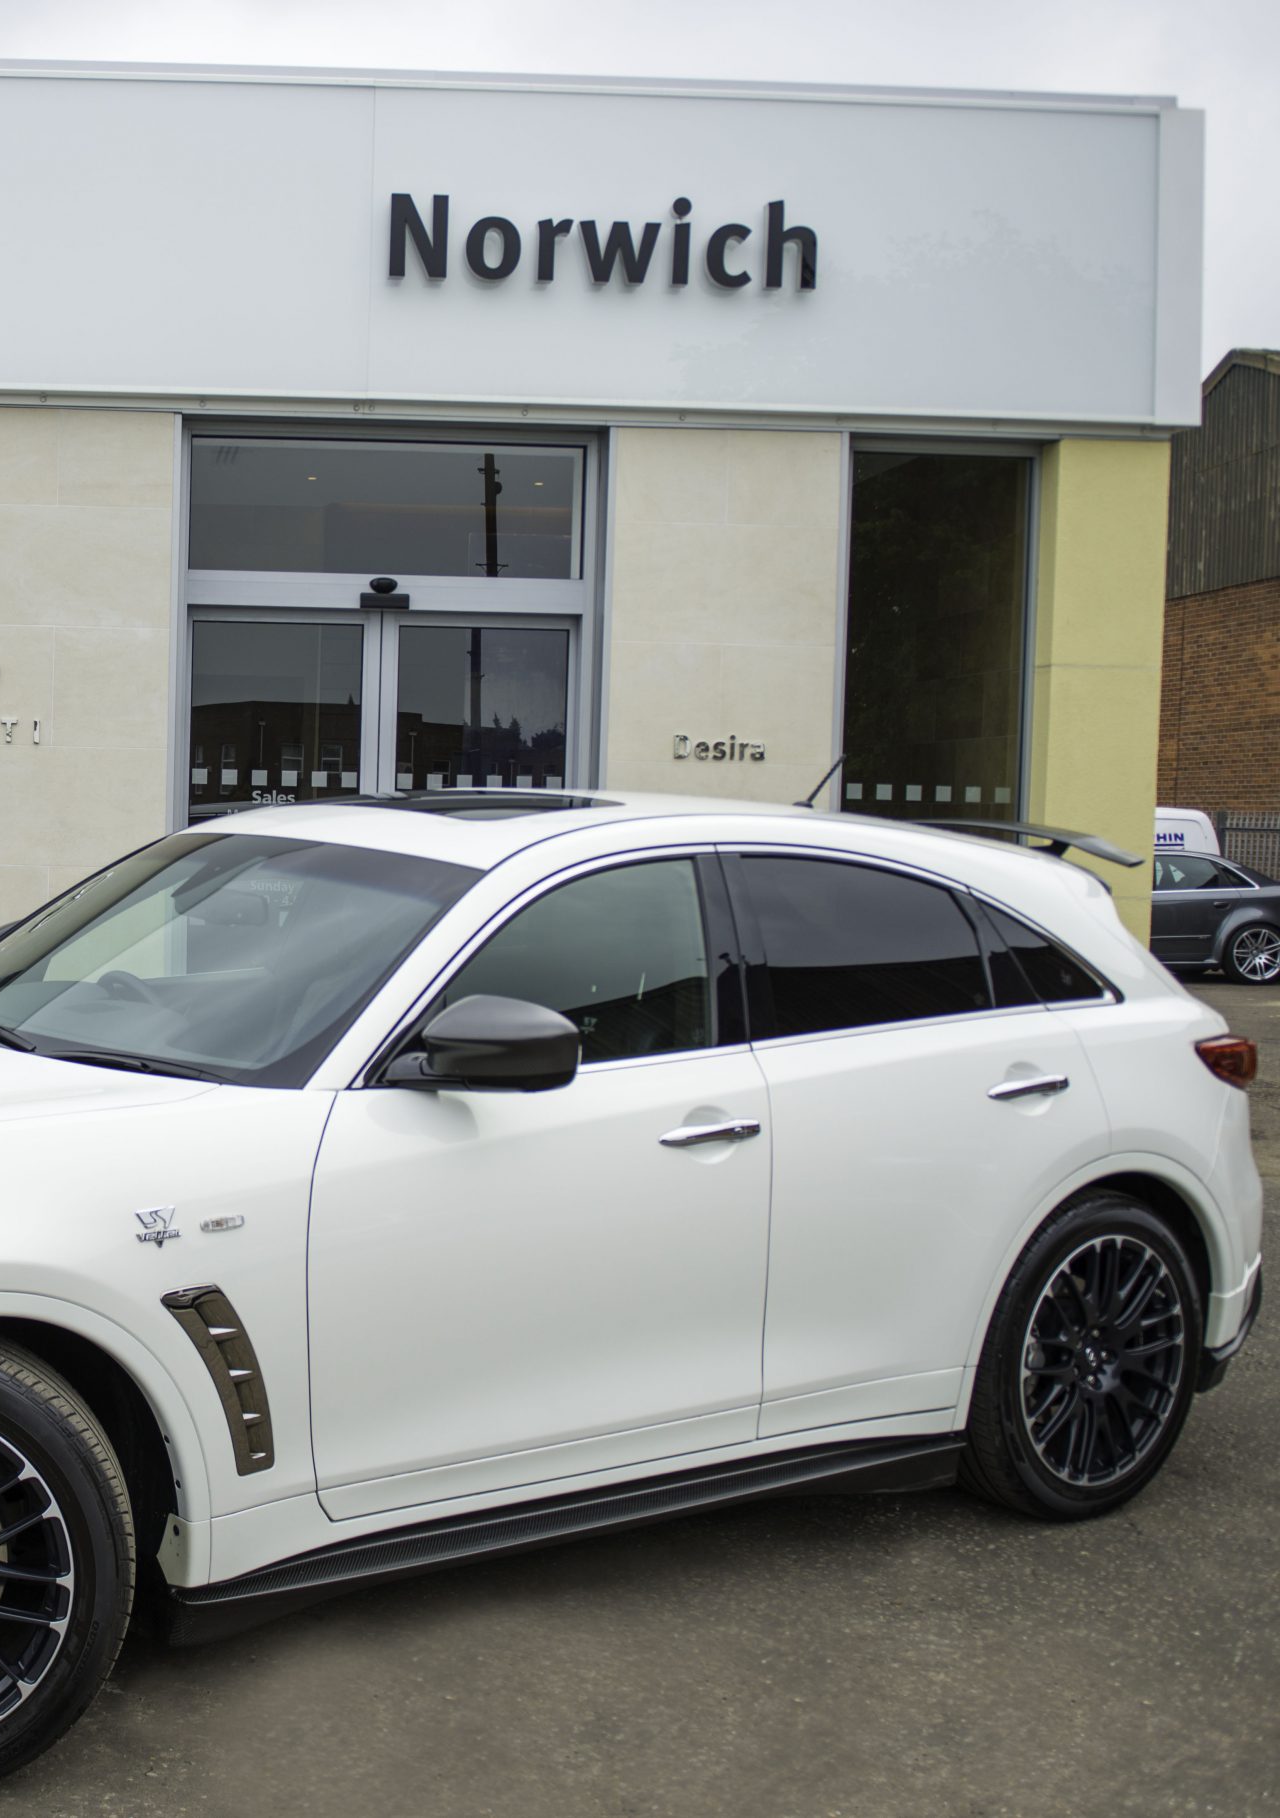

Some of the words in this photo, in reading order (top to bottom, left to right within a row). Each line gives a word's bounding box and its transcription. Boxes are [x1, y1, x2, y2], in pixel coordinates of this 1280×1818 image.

[387, 192, 818, 292] Norwich
[673, 734, 766, 761] Desira
[251, 790, 296, 805] Sales
